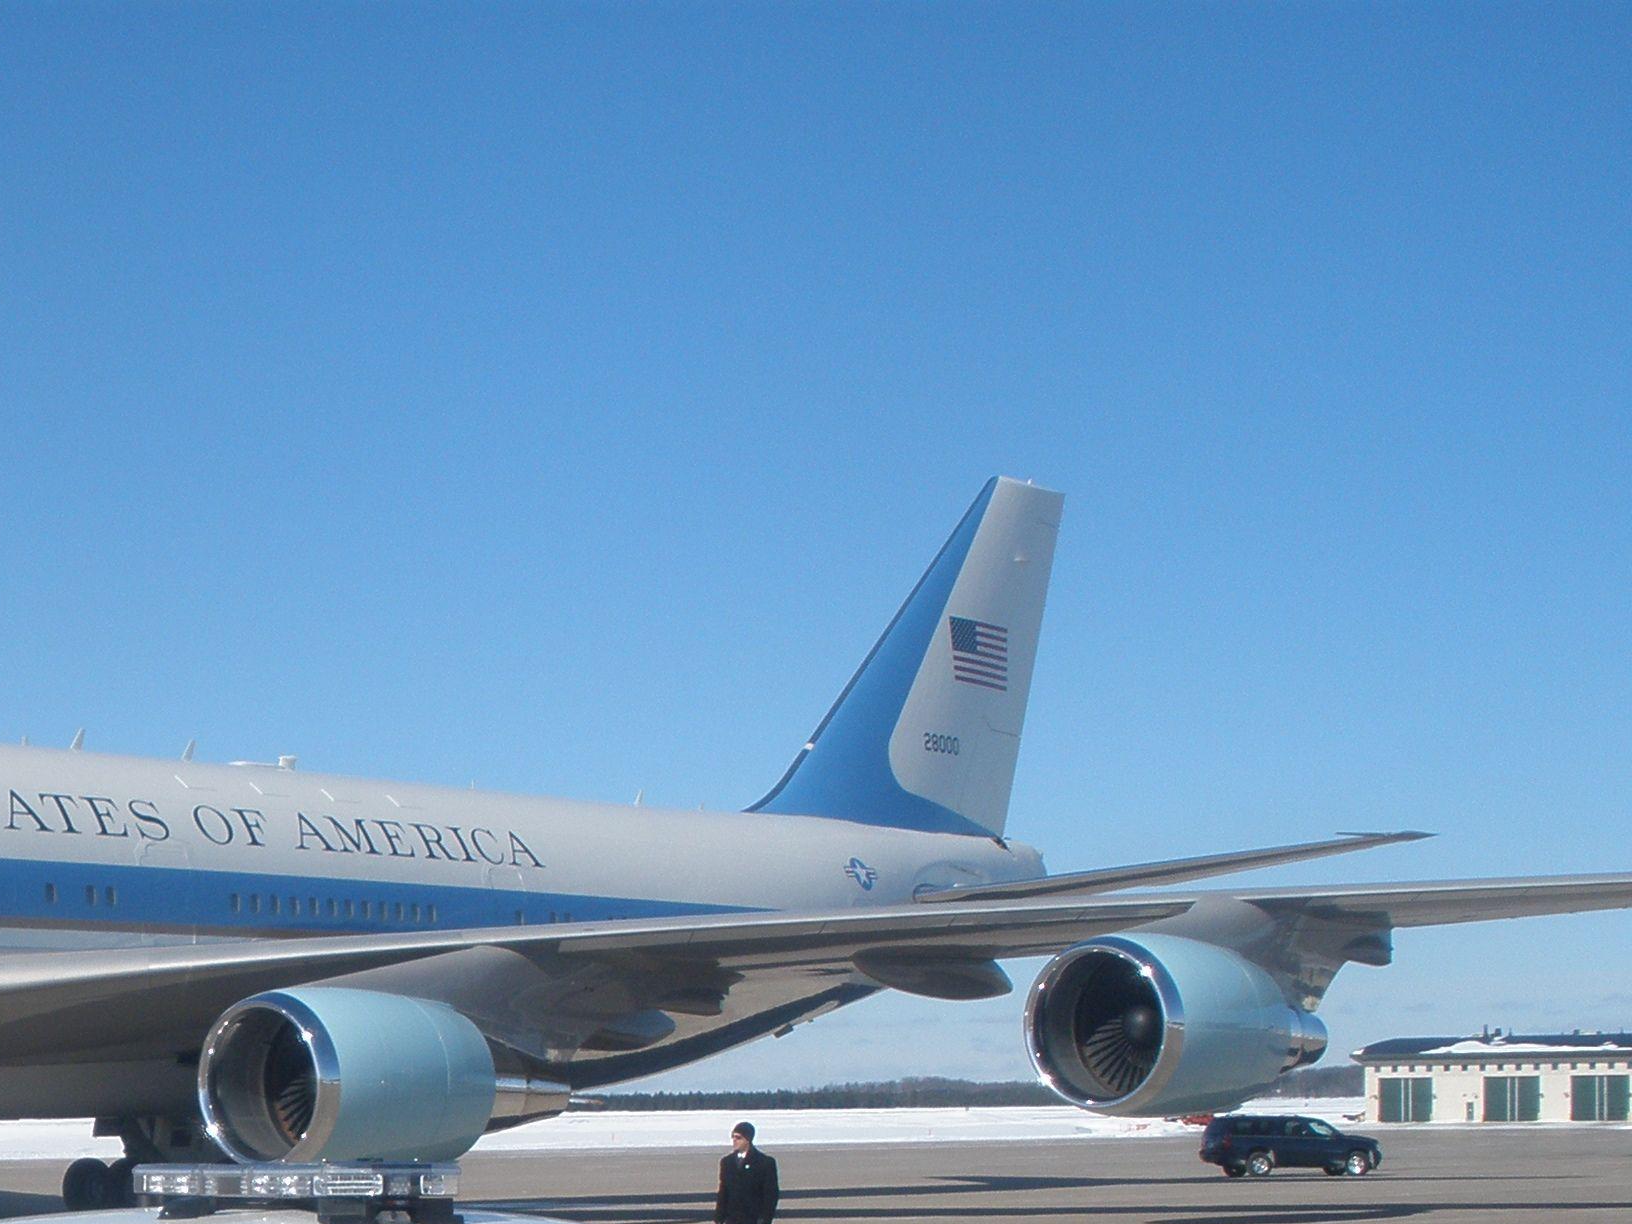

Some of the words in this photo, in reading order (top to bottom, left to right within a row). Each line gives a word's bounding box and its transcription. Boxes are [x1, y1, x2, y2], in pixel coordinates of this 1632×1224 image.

[923, 732, 960, 756] 28000
[192, 804, 267, 848] OF
[295, 811, 547, 869] AMERICA
